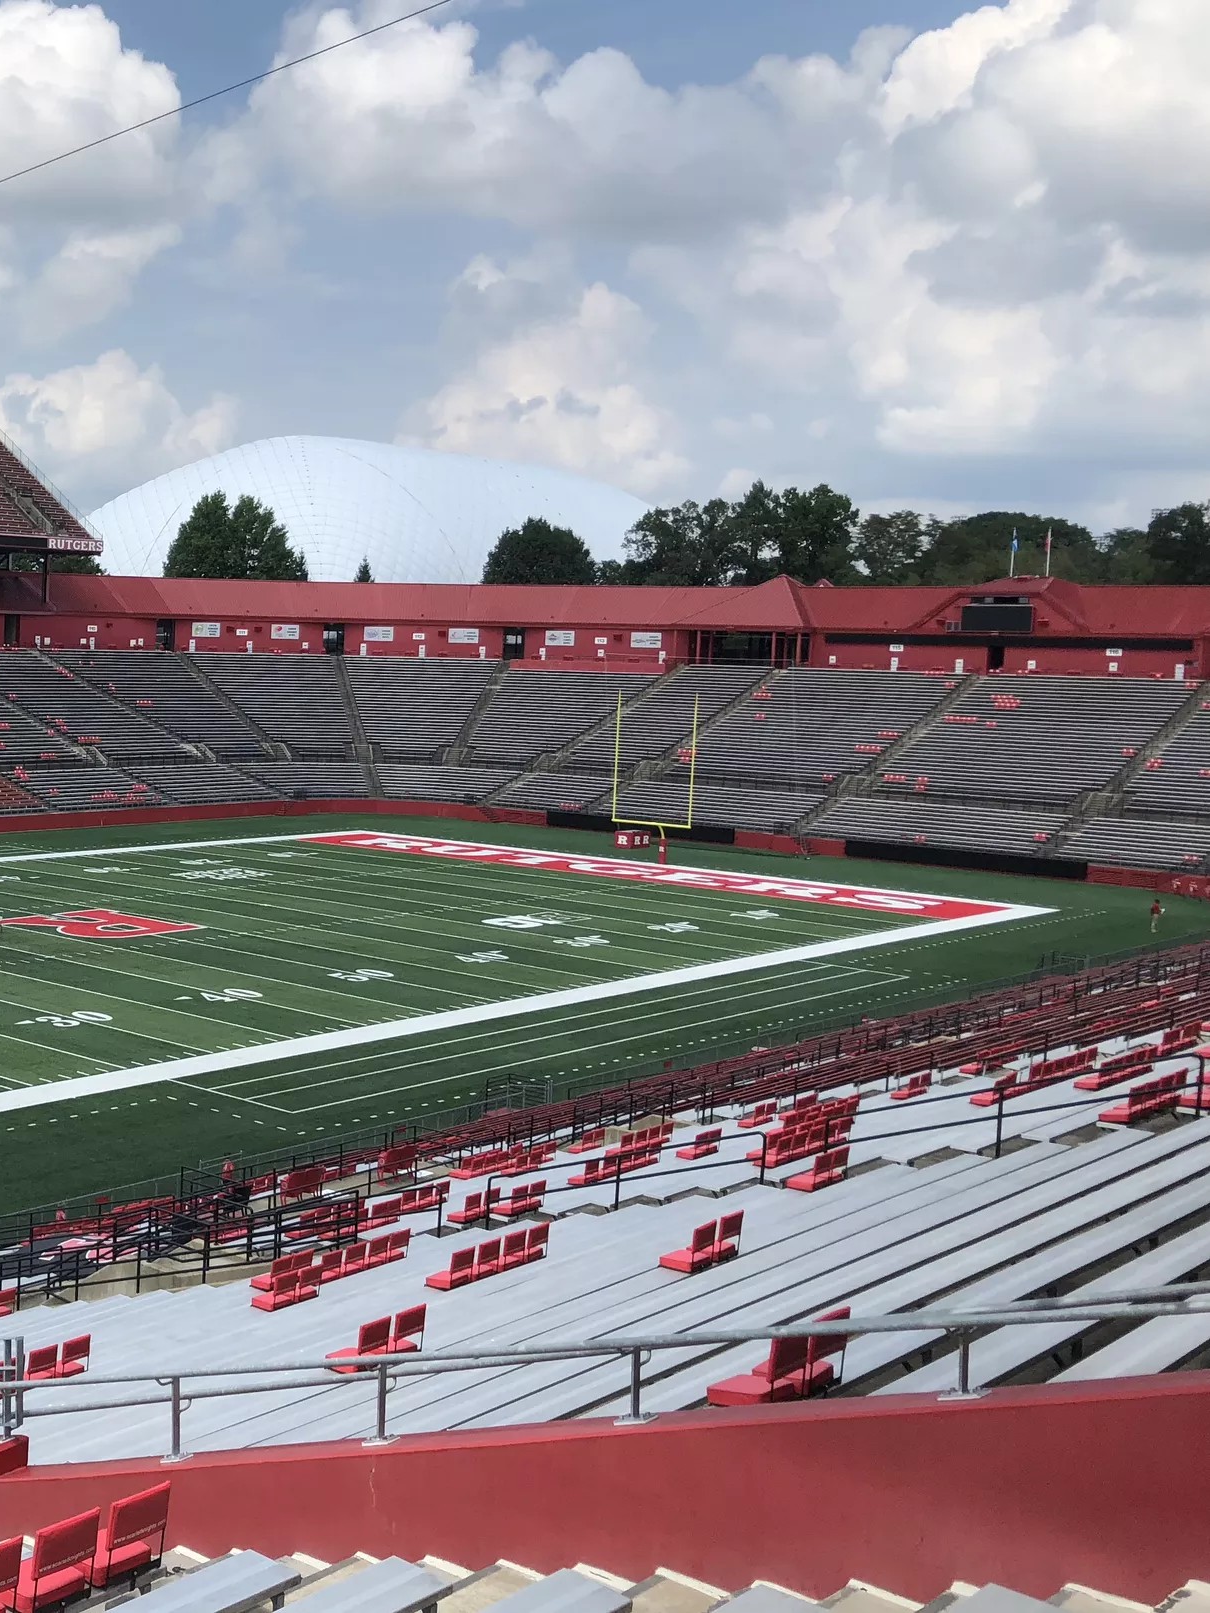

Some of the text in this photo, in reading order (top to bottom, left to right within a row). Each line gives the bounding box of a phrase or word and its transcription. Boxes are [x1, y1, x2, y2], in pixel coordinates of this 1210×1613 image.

[48, 538, 103, 552] RUTGERS
[616, 834, 628, 845] R
[633, 835, 641, 845] R
[642, 834, 650, 845] R
[339, 834, 945, 911] RUTGERS
[326, 968, 395, 982] 50
[199, 988, 264, 1003] 40
[34, 1010, 114, 1028] 30
